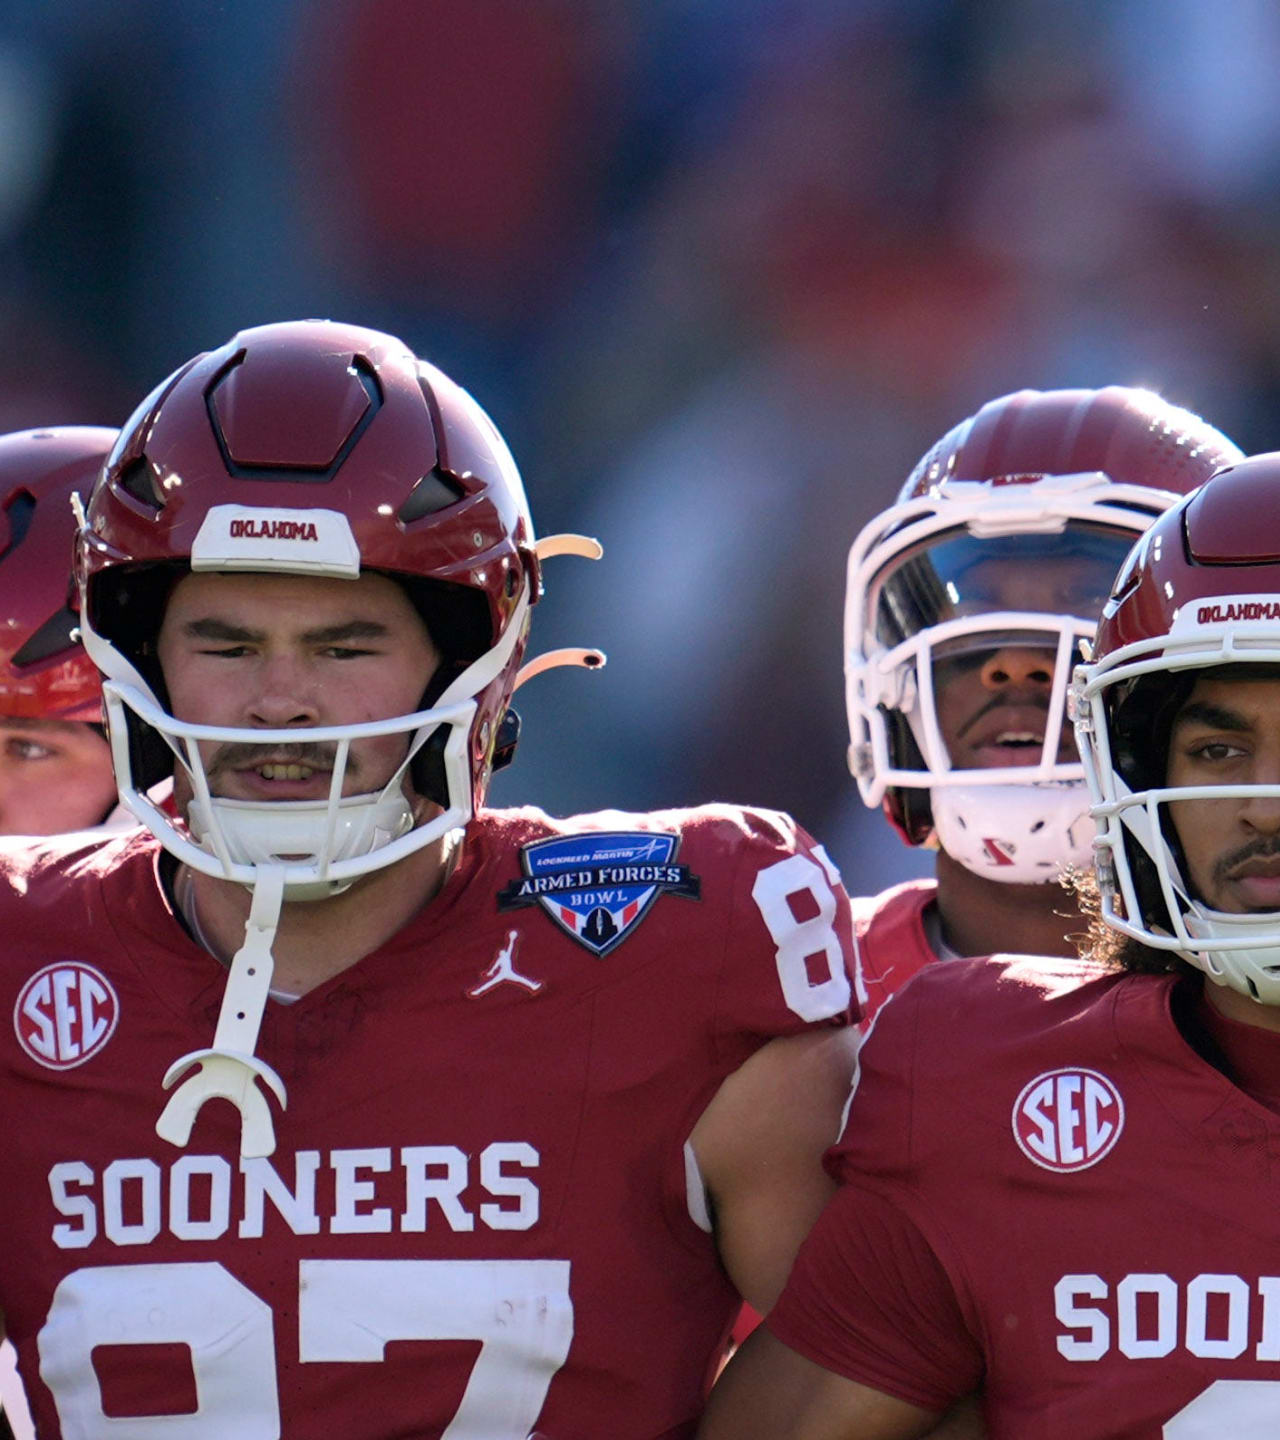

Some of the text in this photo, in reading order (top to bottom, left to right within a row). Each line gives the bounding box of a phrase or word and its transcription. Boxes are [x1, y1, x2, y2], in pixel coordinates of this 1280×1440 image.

[230, 519, 318, 542] OKLAHOMA
[519, 866, 681, 896] ARMED FORCES
[536, 850, 634, 867] LOCKHEED MARTIN
[570, 890, 628, 906] BOWL
[752, 845, 868, 1023] 8
[23, 968, 108, 1061] SEC
[1022, 1075, 1113, 1164] SEC
[48, 1141, 540, 1249] SOONERS
